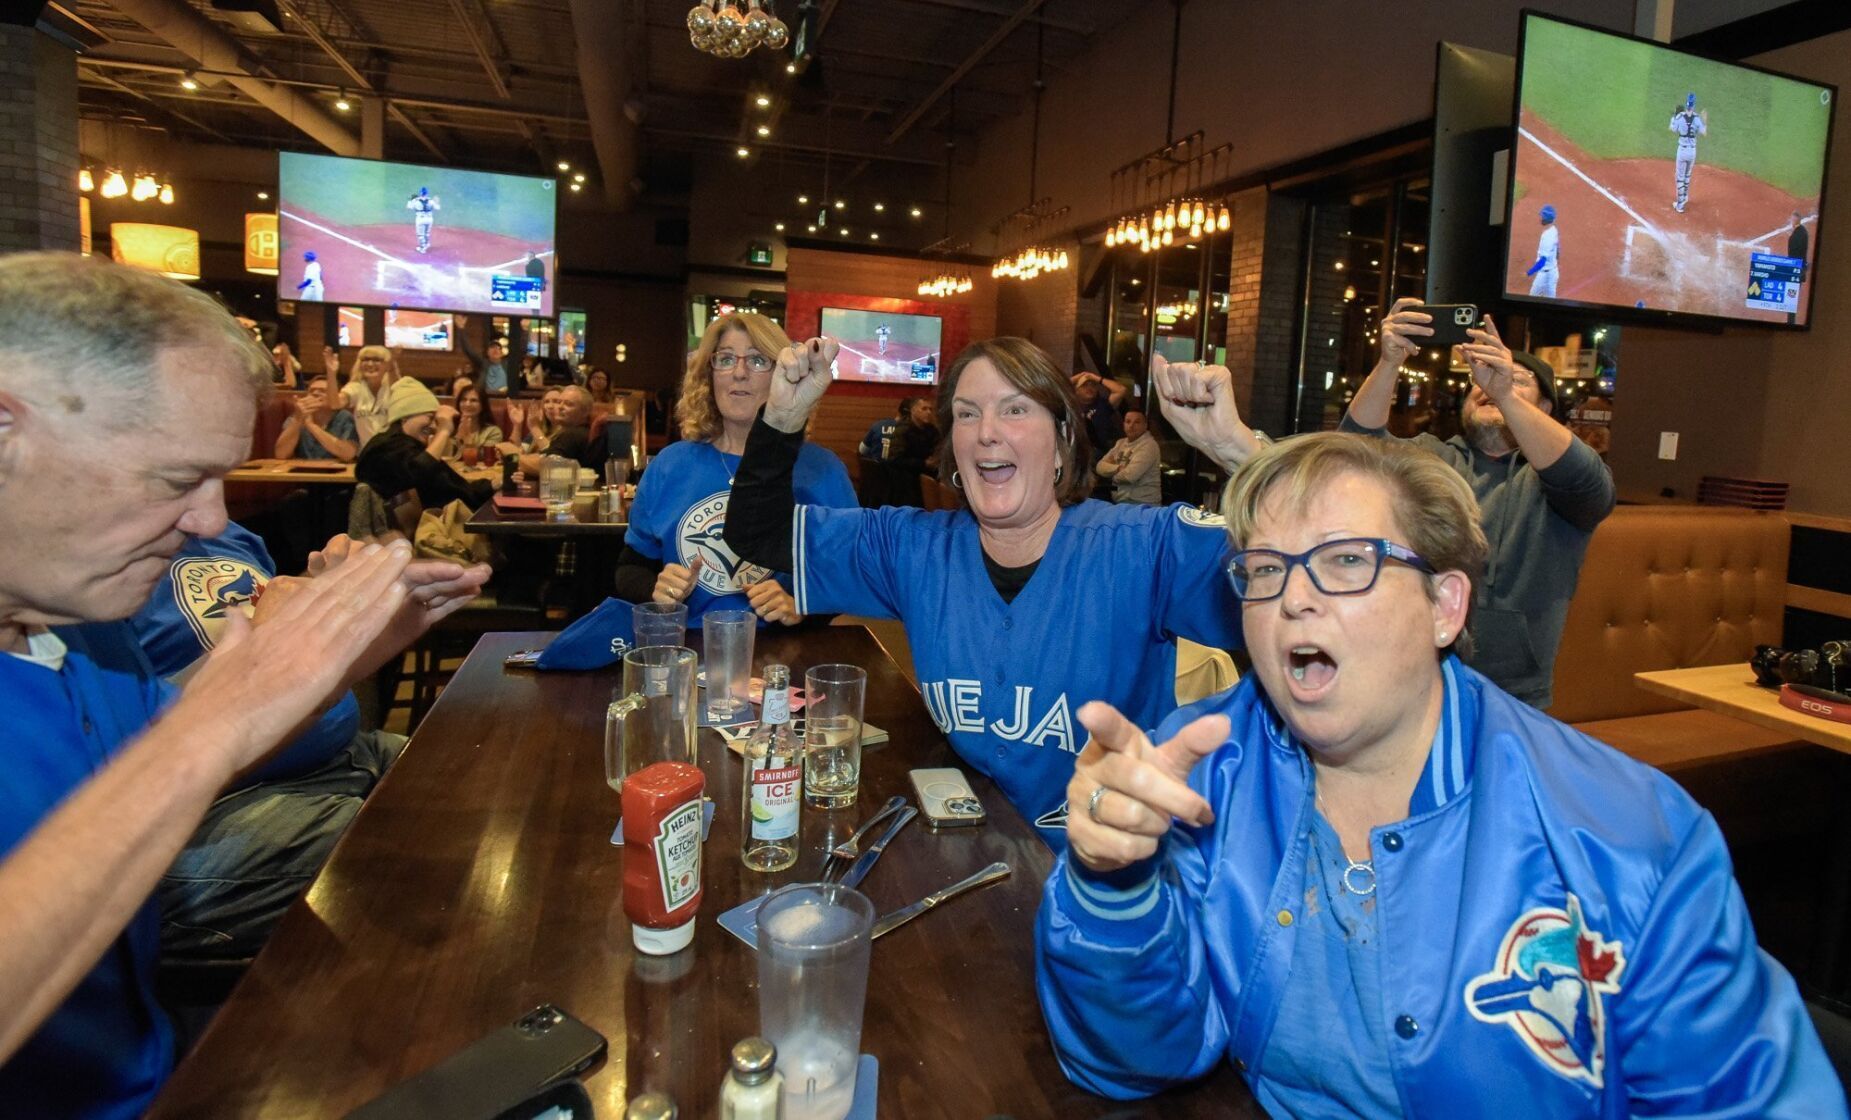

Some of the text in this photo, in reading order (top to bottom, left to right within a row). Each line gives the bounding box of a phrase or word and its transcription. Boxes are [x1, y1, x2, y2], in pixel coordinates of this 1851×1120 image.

[687, 501, 724, 530] TORO
[187, 564, 235, 604] TORONTO
[1800, 700, 1833, 715] EOS
[758, 767, 799, 782] SMIRNOFF
[766, 783, 793, 798] ICE
[765, 797, 794, 807] ORIGINAL
[671, 811, 696, 832] HEINZ
[668, 831, 698, 857] KETCHUP
